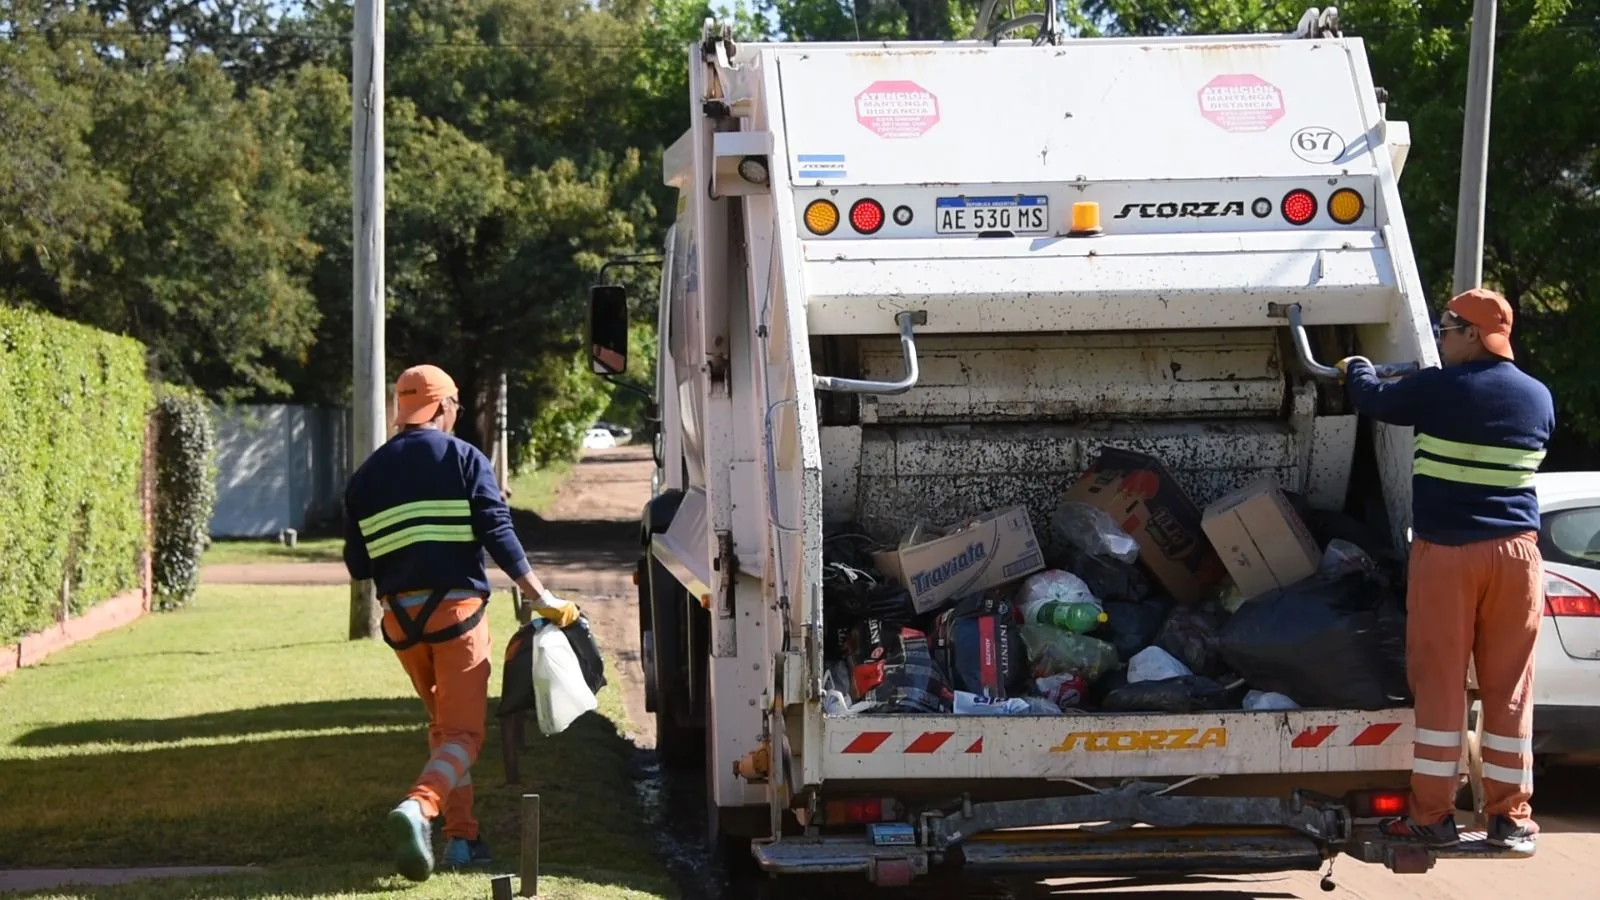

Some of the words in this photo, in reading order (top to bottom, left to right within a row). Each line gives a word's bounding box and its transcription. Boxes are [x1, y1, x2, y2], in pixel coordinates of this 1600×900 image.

[1297, 132, 1333, 151] 67
[942, 209, 966, 230] AE
[974, 209, 1010, 229] 530
[1018, 207, 1043, 229] MS
[1113, 201, 1244, 219] SCORZA
[910, 541, 986, 597] Traviata
[1000, 623, 1009, 677] INFINITY
[1048, 727, 1226, 752] SCORZA
